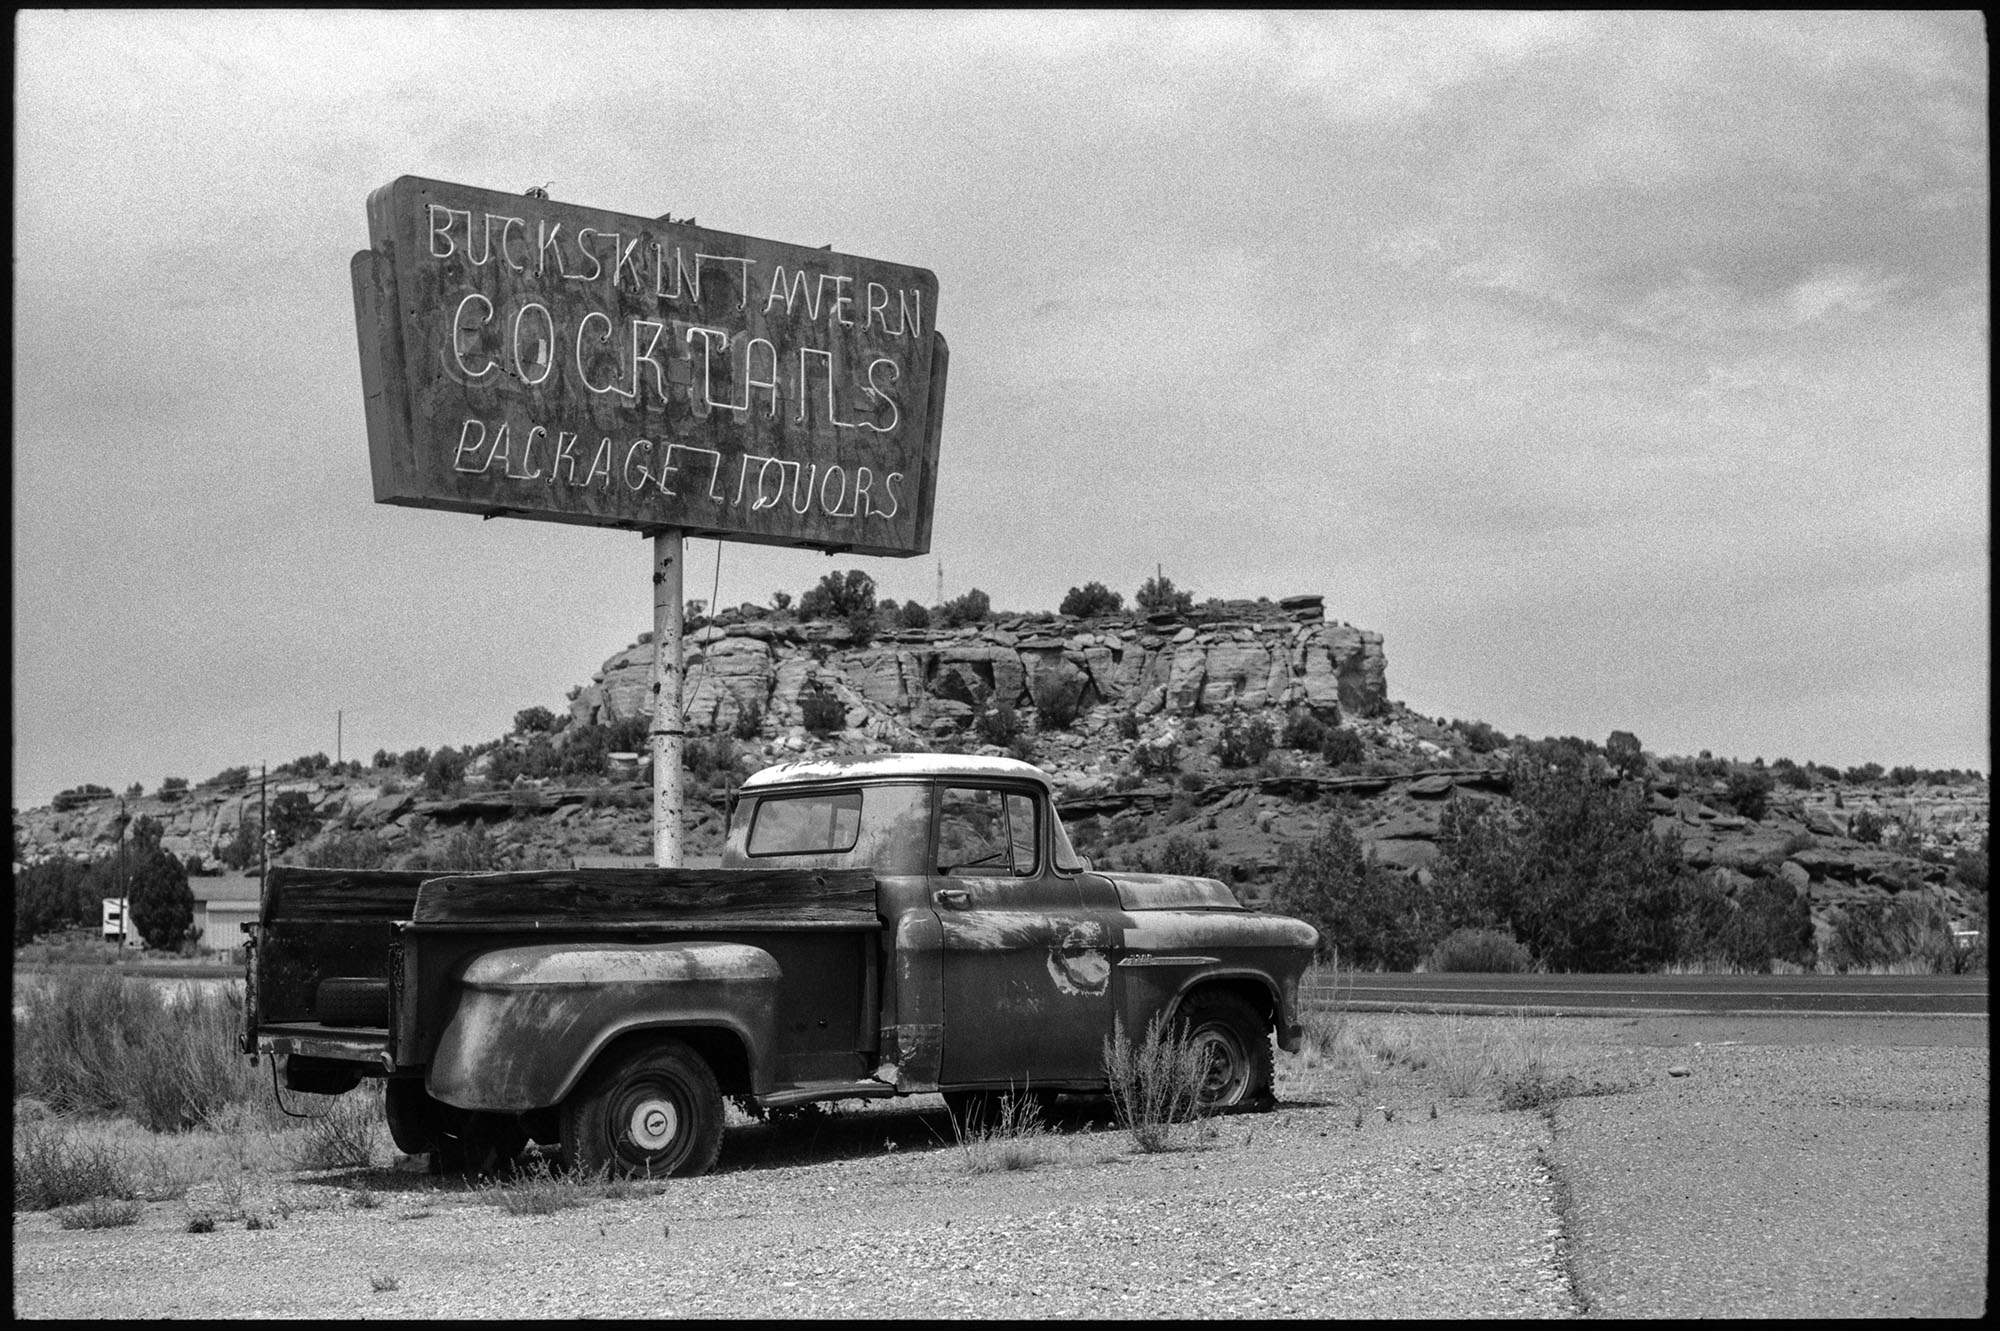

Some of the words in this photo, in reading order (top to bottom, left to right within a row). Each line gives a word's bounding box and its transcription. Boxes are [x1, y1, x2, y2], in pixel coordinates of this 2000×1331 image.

[427, 204, 700, 303] BUCKSKIN
[728, 255, 921, 338] TAVERN
[452, 294, 901, 432] COCKTAILS
[453, 419, 678, 497] PACKAGE
[708, 451, 904, 519] LIQUORS
